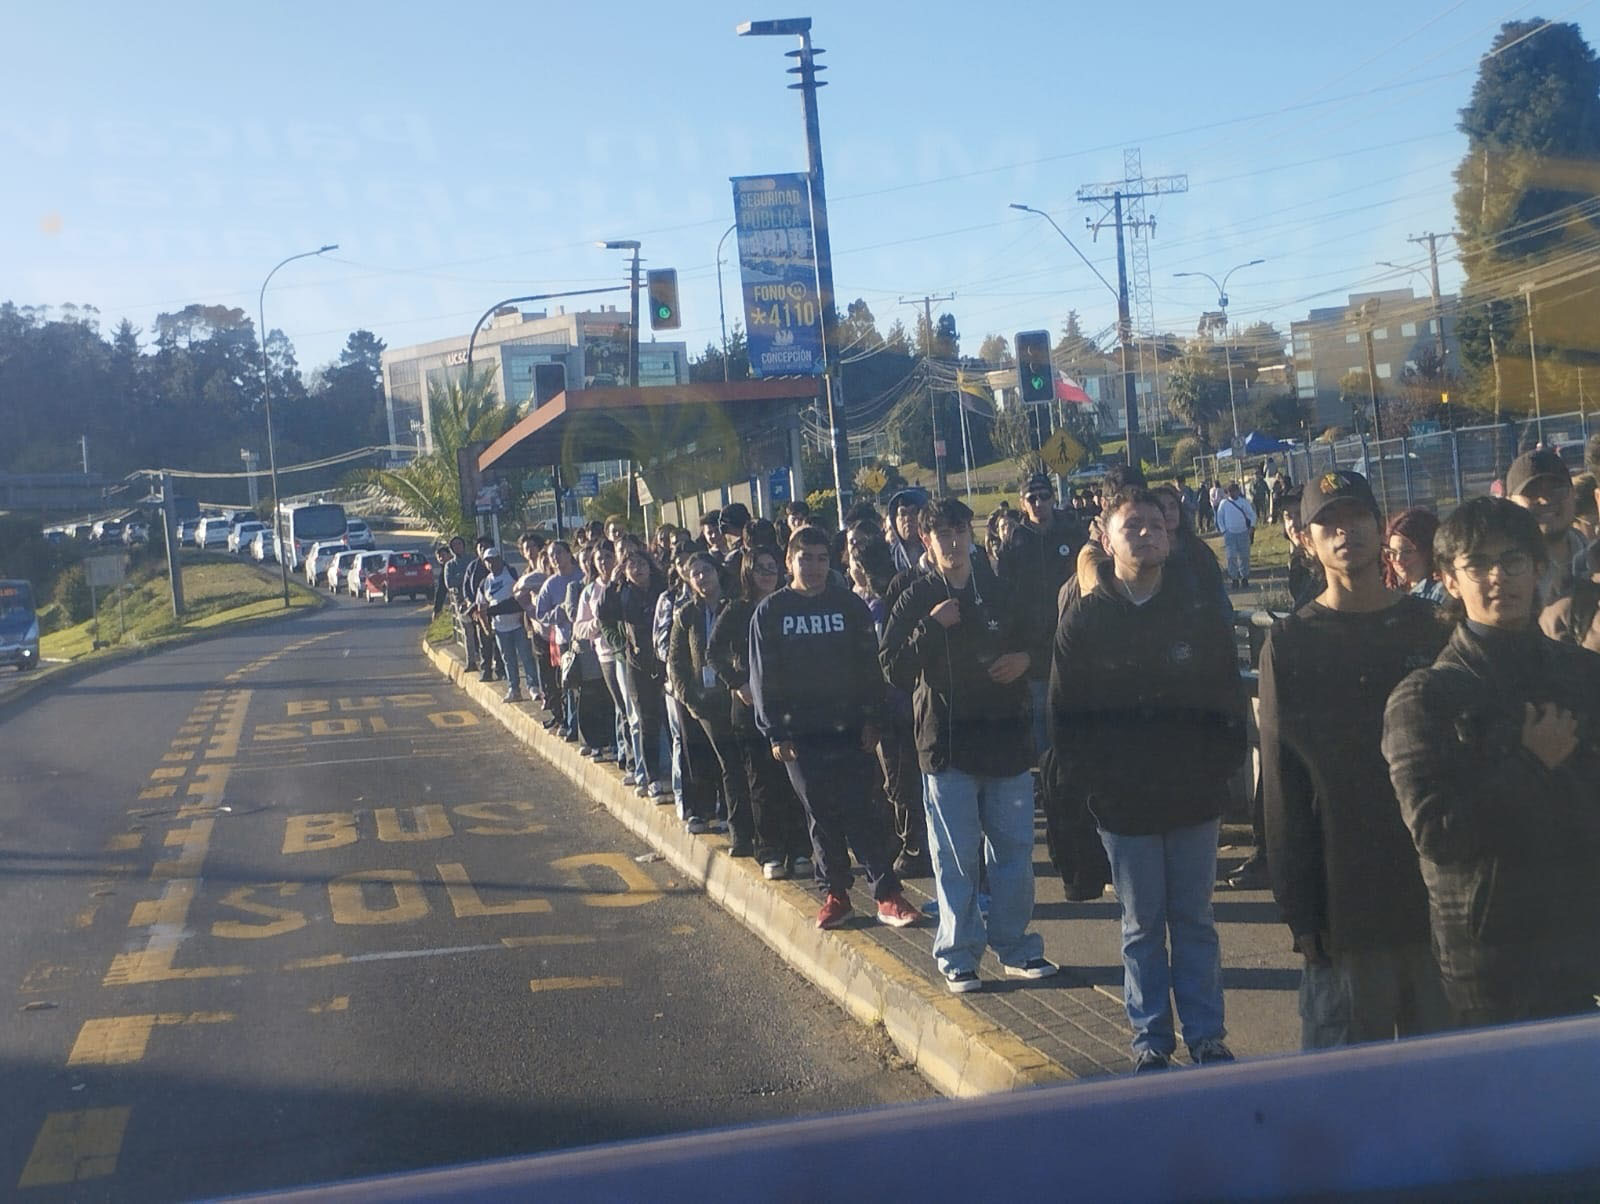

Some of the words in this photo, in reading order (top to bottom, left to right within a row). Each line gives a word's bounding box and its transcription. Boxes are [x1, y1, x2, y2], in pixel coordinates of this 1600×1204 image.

[740, 190, 801, 208] SEGURIDAD
[754, 284, 786, 303] FONO
[761, 349, 812, 364] CONCEPCIÓN
[783, 613, 844, 635] PARIS
[287, 693, 438, 716] BUS
[253, 710, 480, 741] SOLO
[282, 802, 547, 854] BUS
[210, 853, 665, 938] SOLO
